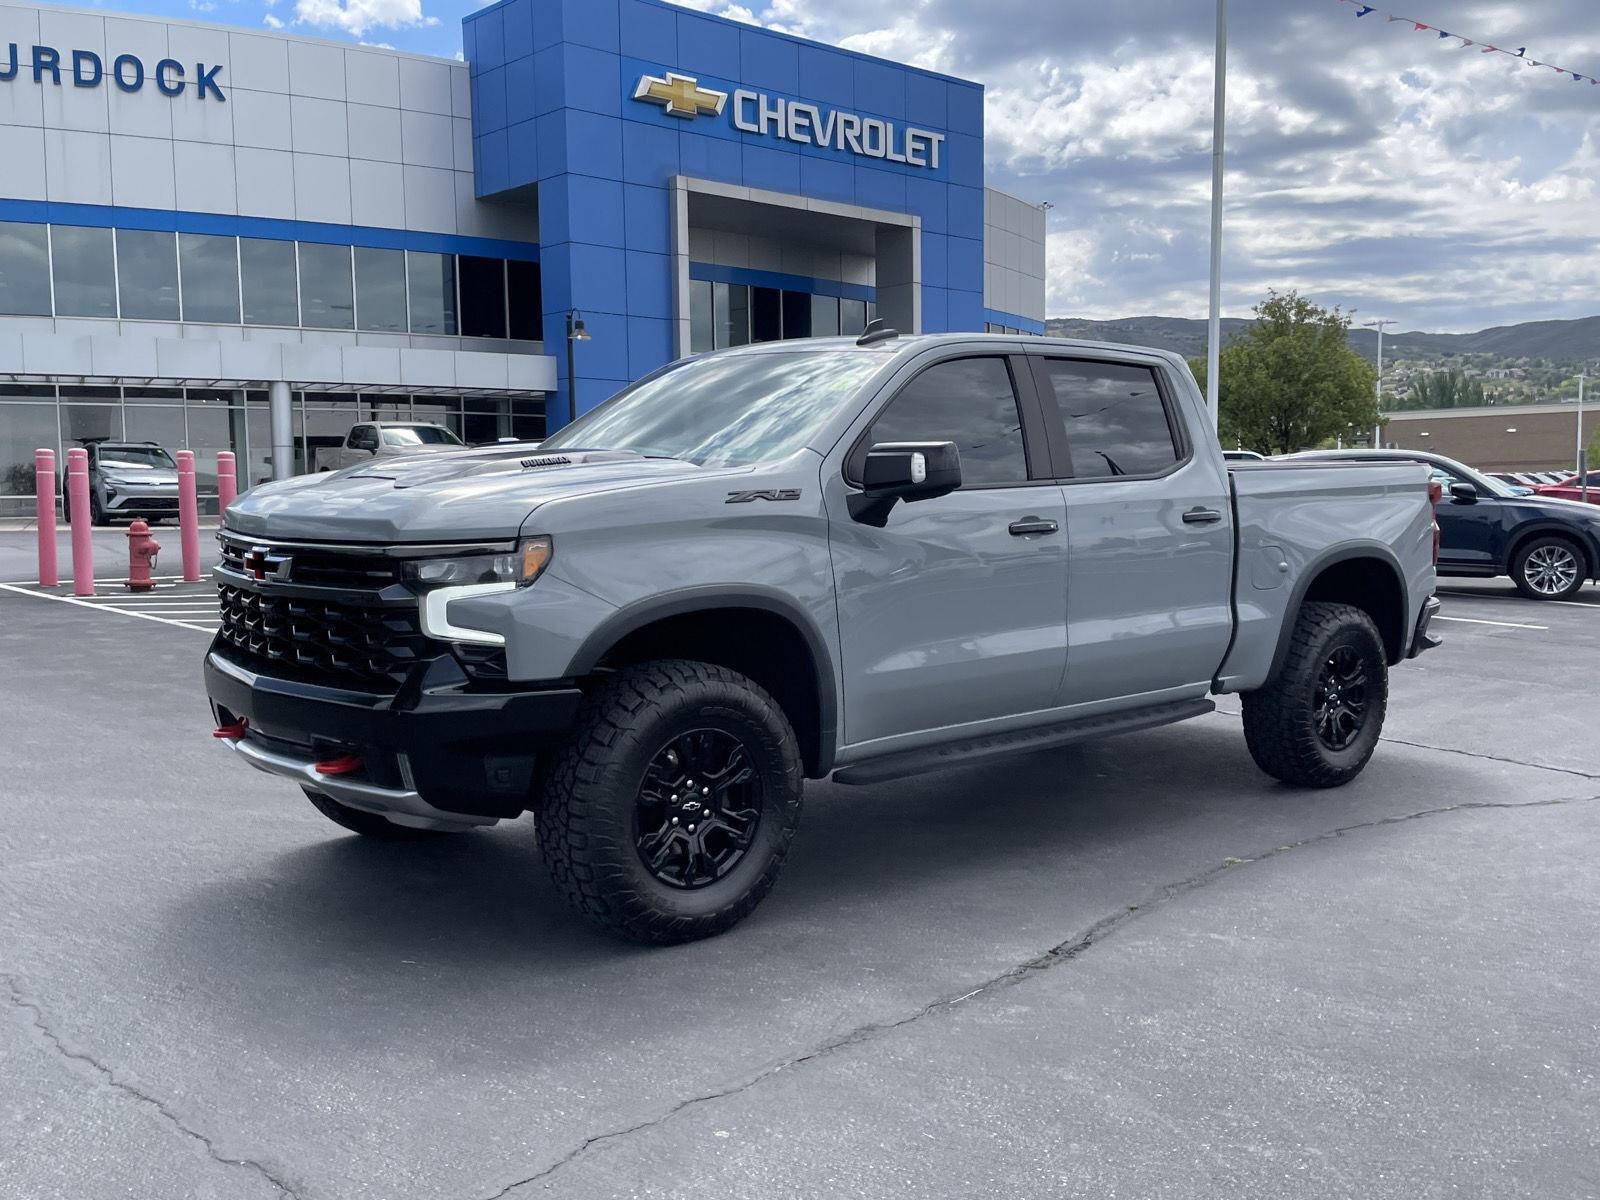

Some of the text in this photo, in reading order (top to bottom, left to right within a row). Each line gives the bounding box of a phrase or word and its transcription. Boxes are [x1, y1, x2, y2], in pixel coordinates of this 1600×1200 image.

[733, 88, 945, 169] CHEVROLET
[520, 456, 572, 468] DURAMAX
[725, 488, 802, 504] ZR2
